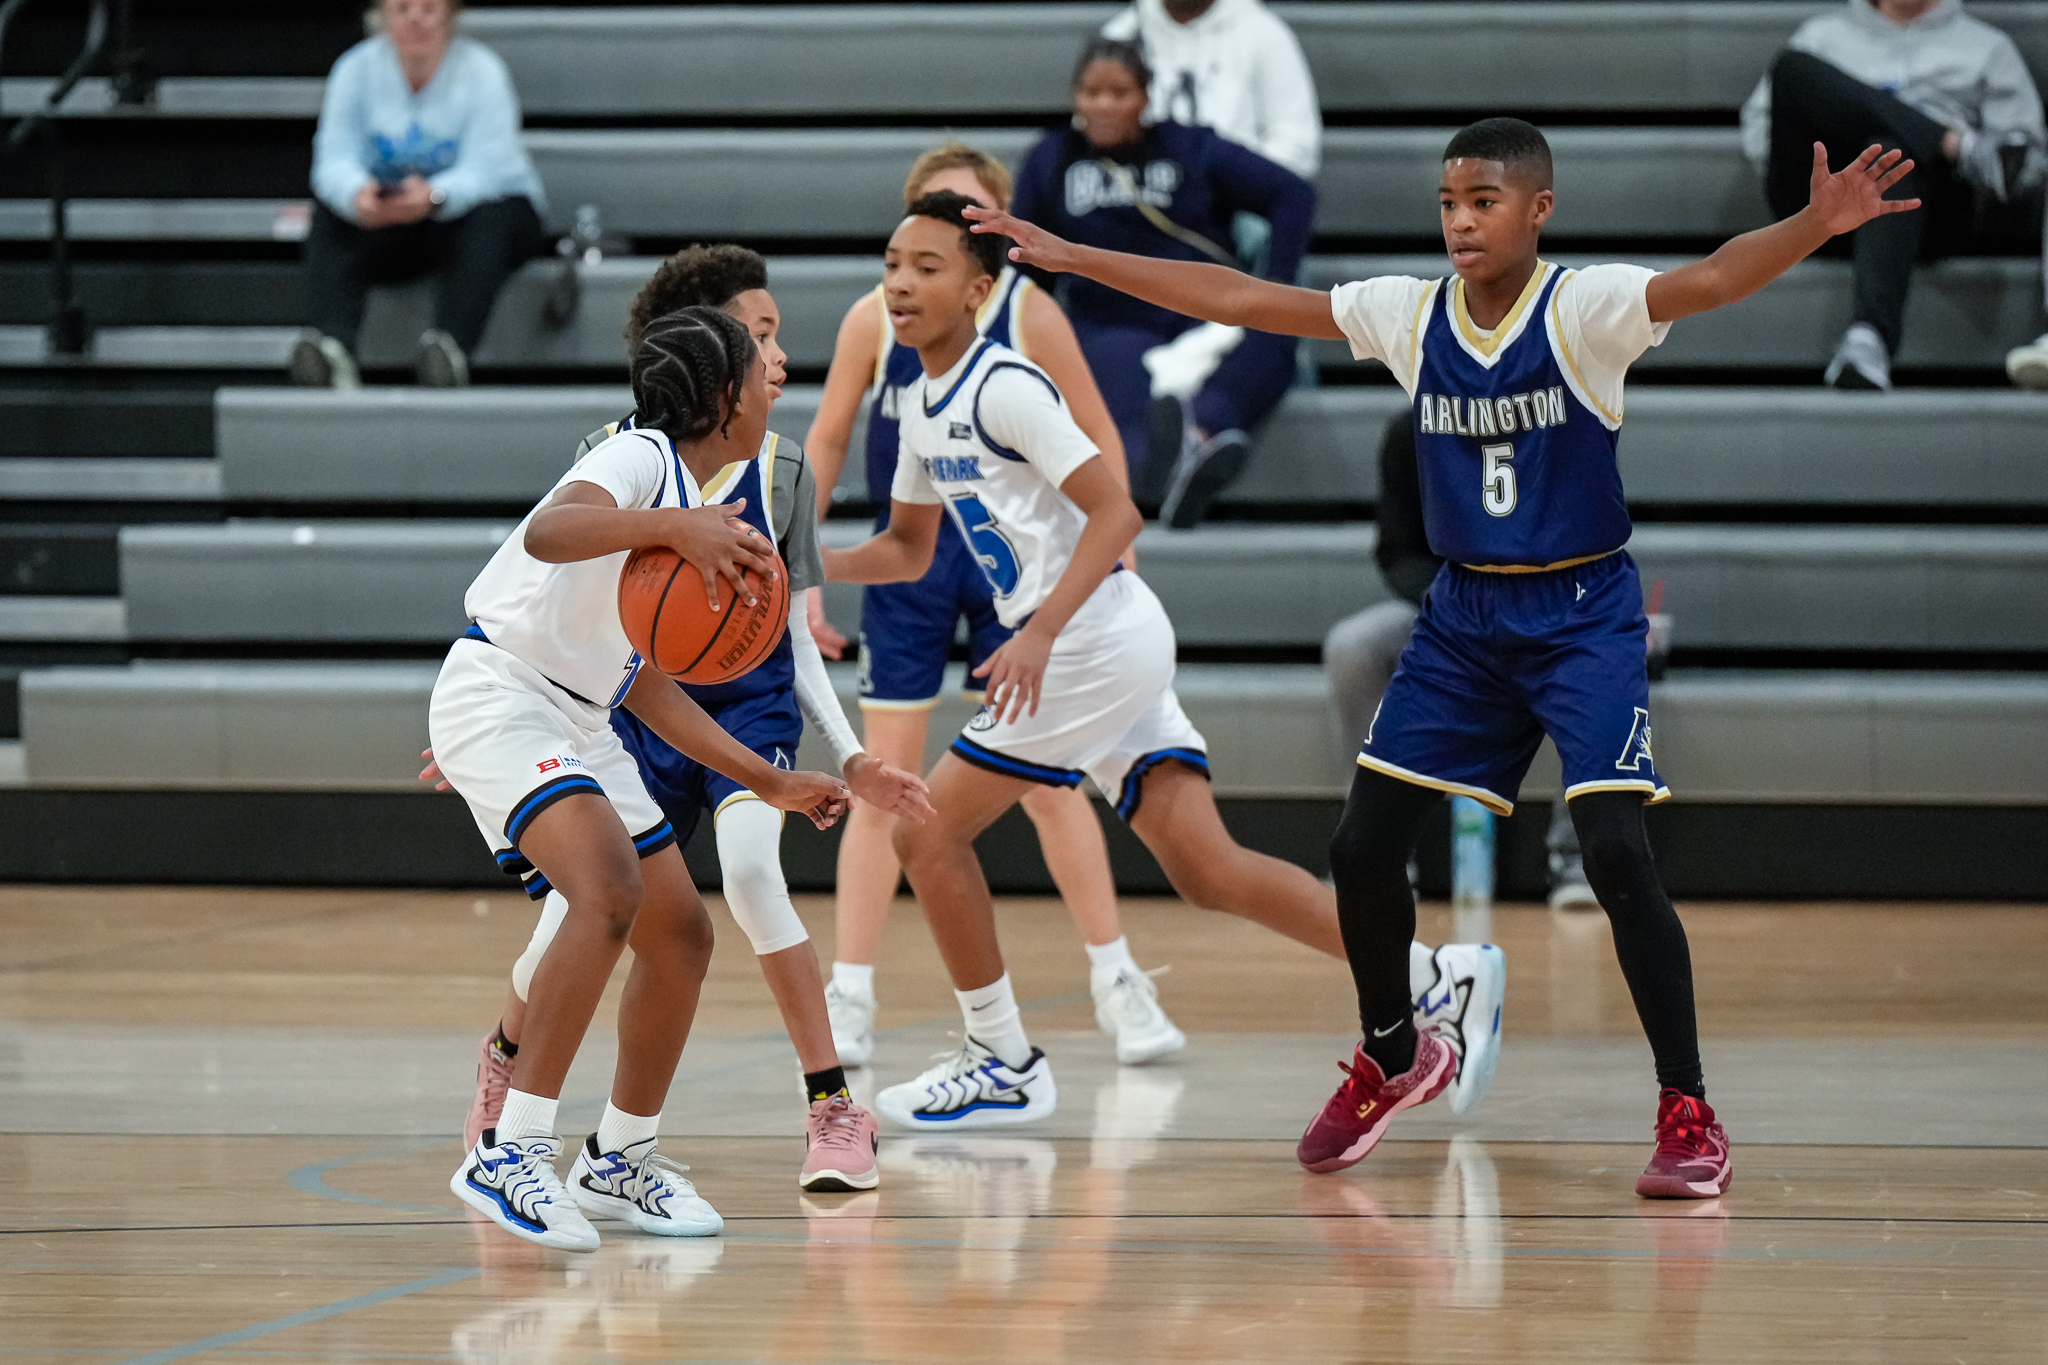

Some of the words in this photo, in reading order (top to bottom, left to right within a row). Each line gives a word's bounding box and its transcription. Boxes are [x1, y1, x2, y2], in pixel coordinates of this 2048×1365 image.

[1420, 386, 1566, 436] ARLINGTON
[1481, 442, 1517, 517] 5
[949, 491, 1022, 601] 5
